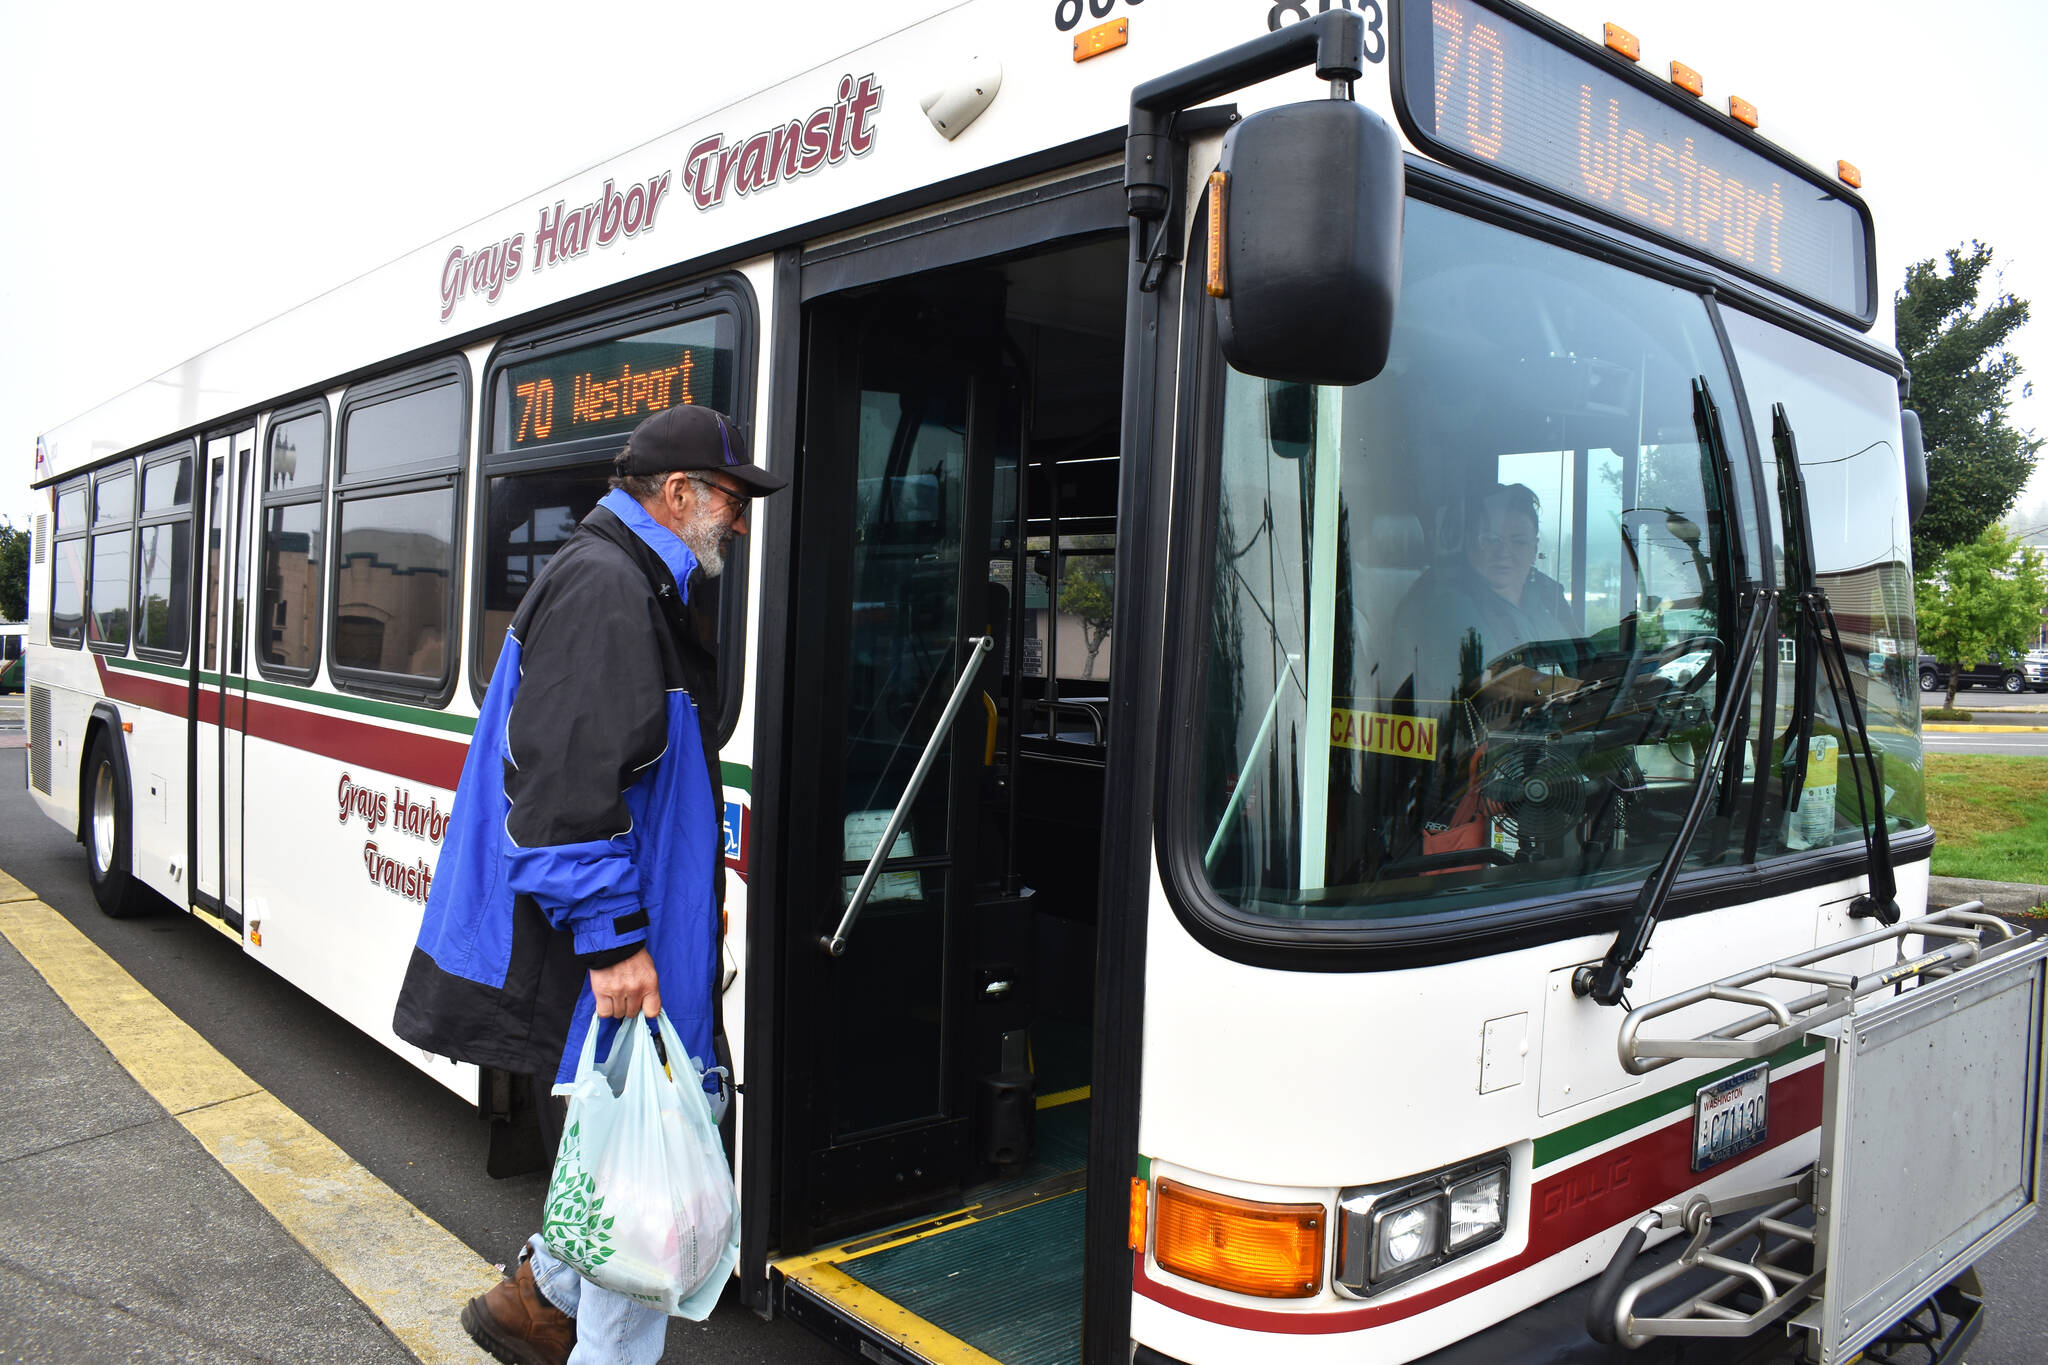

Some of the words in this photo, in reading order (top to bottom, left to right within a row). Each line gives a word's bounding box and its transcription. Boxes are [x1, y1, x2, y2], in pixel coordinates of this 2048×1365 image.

[1432, 0, 1503, 160] 70
[1580, 84, 1783, 274] Westport
[440, 233, 526, 322] Grays
[532, 169, 671, 273] Harbor
[682, 72, 882, 211] Transit
[517, 378, 554, 442] 70
[573, 350, 695, 424] Westport
[1331, 712, 1434, 756] CAUTION
[338, 772, 388, 834] Grays
[393, 786, 451, 845] Harbo
[1703, 1086, 1743, 1112] WASHINGTON
[1711, 1094, 1764, 1150] C7113C
[1543, 1155, 1633, 1221] GILLIG
